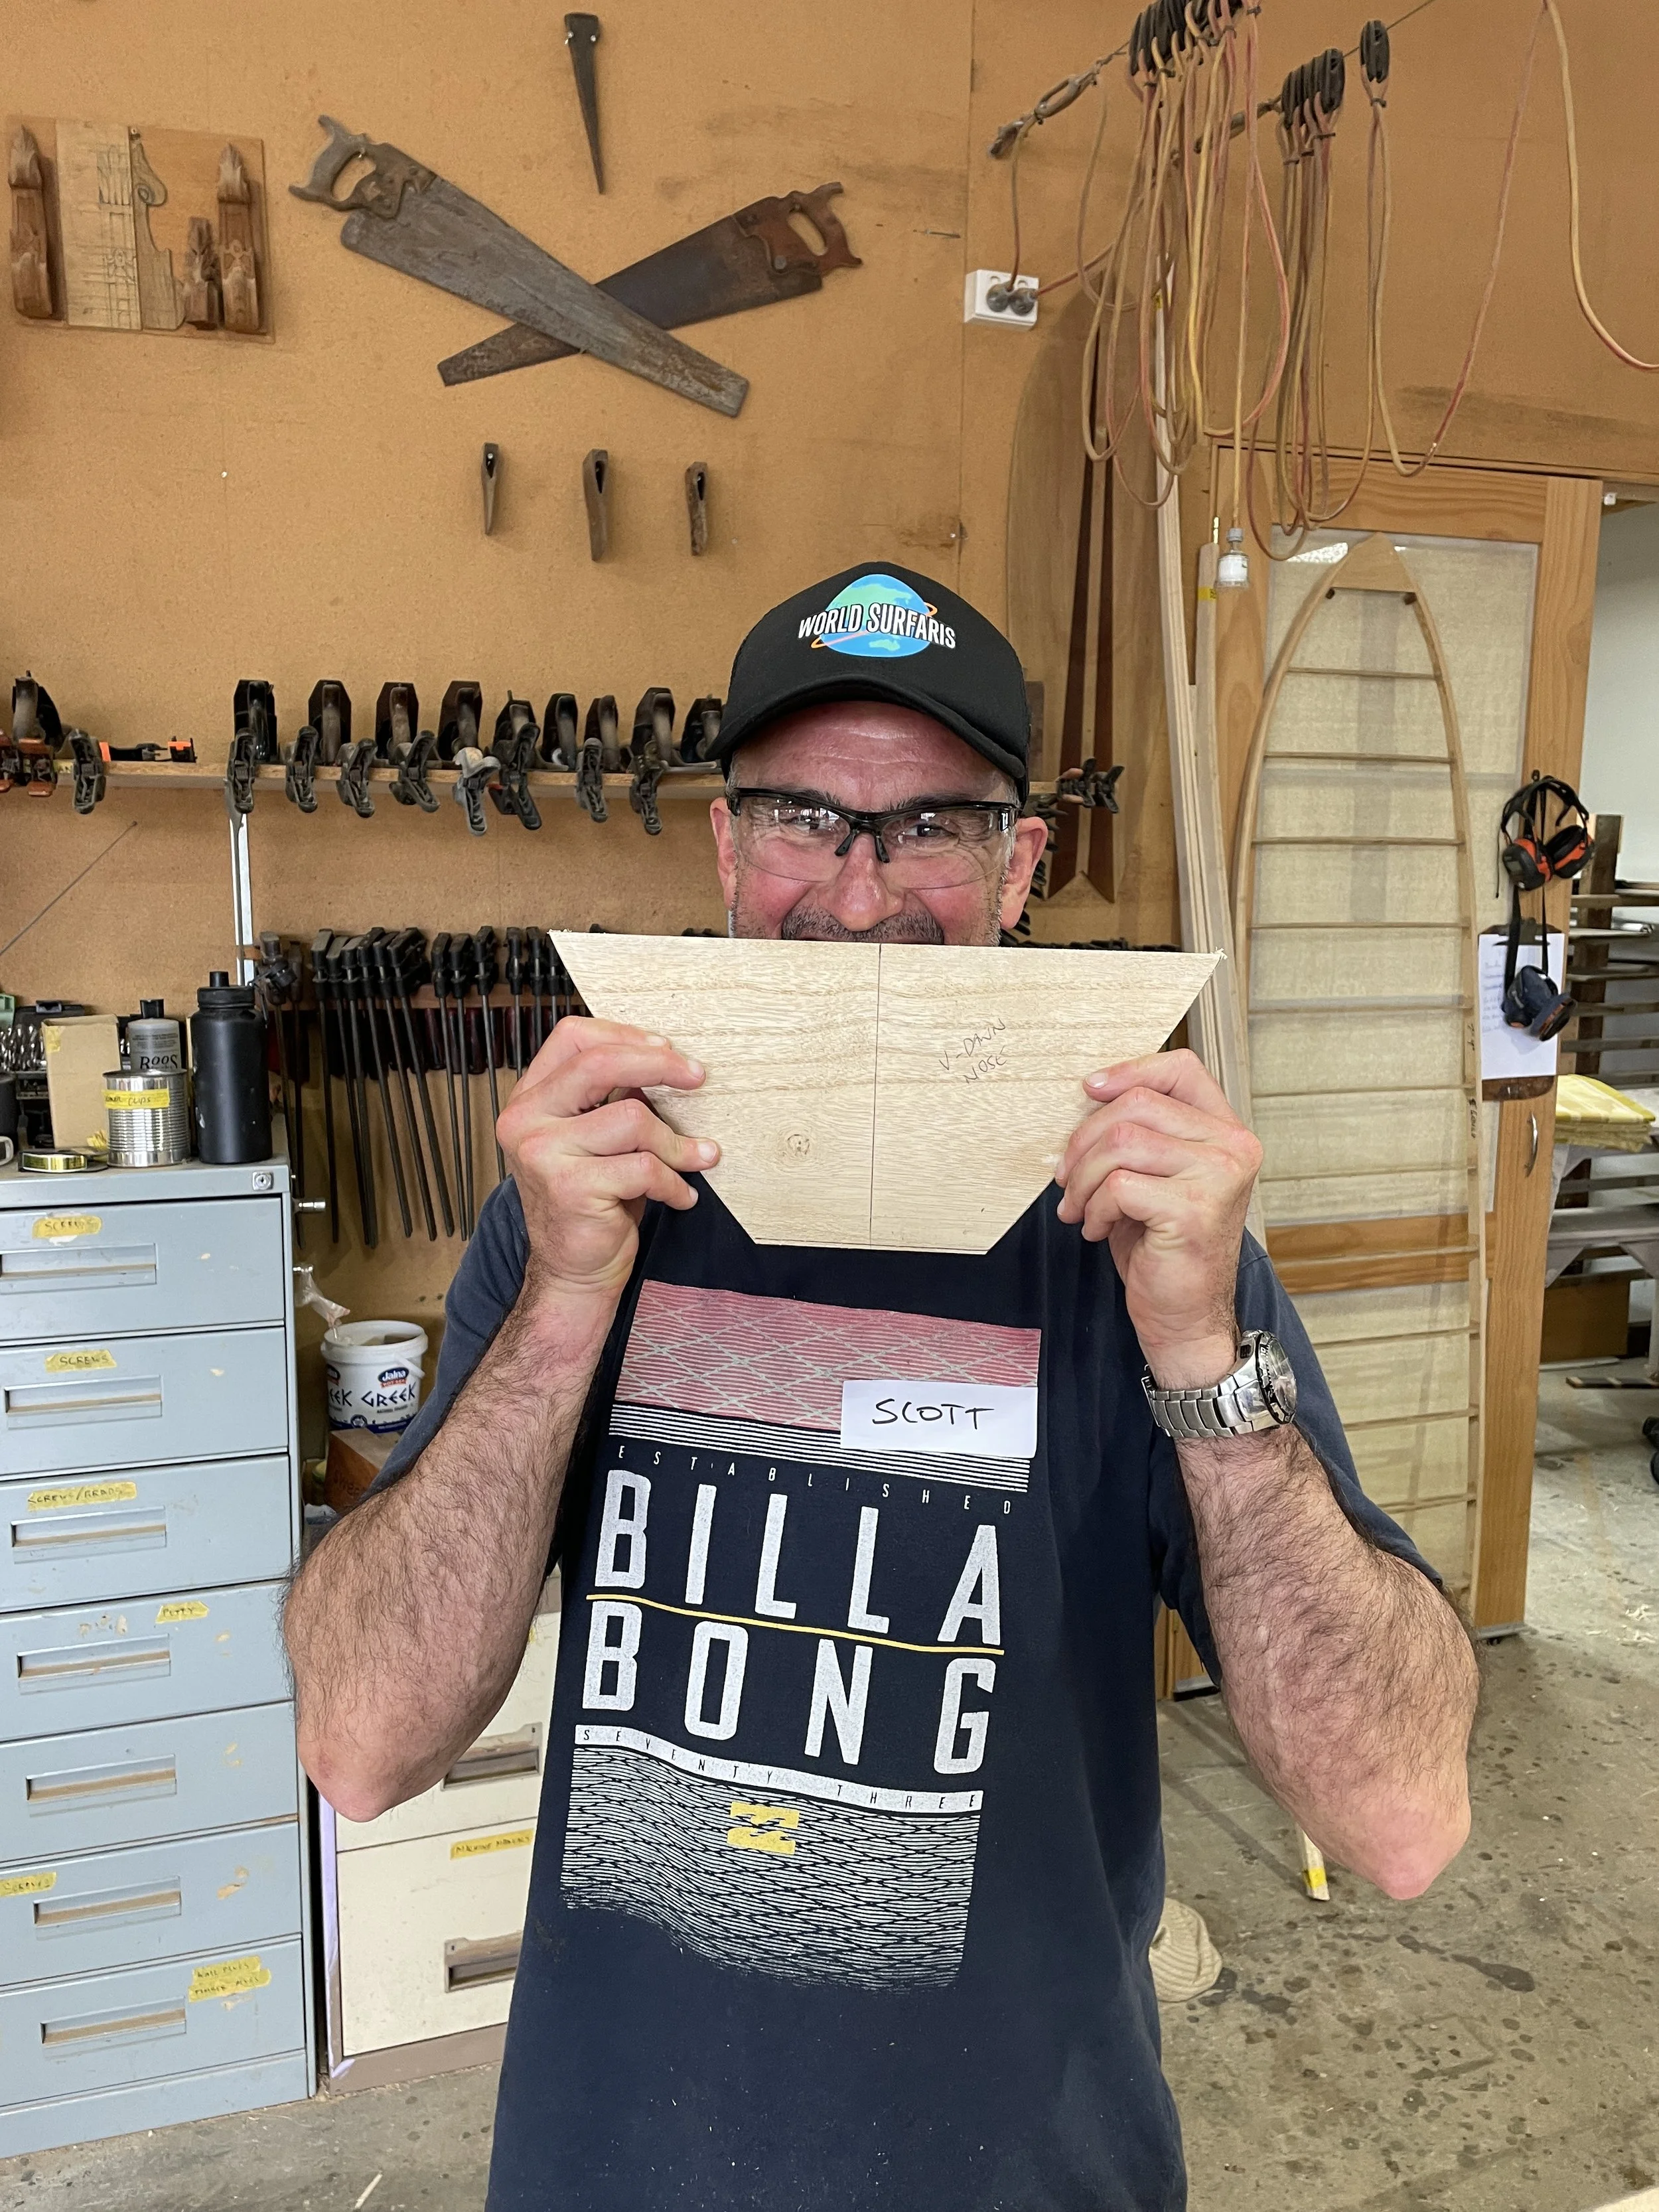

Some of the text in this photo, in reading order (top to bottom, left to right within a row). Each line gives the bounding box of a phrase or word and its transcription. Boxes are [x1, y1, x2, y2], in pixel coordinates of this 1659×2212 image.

[798, 603, 956, 649] WORLD SURFARIS
[963, 1045, 1007, 1084] NOSE
[59, 1355, 109, 1364] SCREWS
[382, 1370, 406, 1382] Jalna
[361, 1382, 417, 1408] GREEK
[872, 1398, 995, 1430] SCOTT
[618, 1445, 1011, 1514] ESTABLISHED
[595, 1469, 1001, 1646] BILLA
[582, 1600, 996, 1774] BONG
[583, 1729, 975, 1809] SEVENTY THREE
